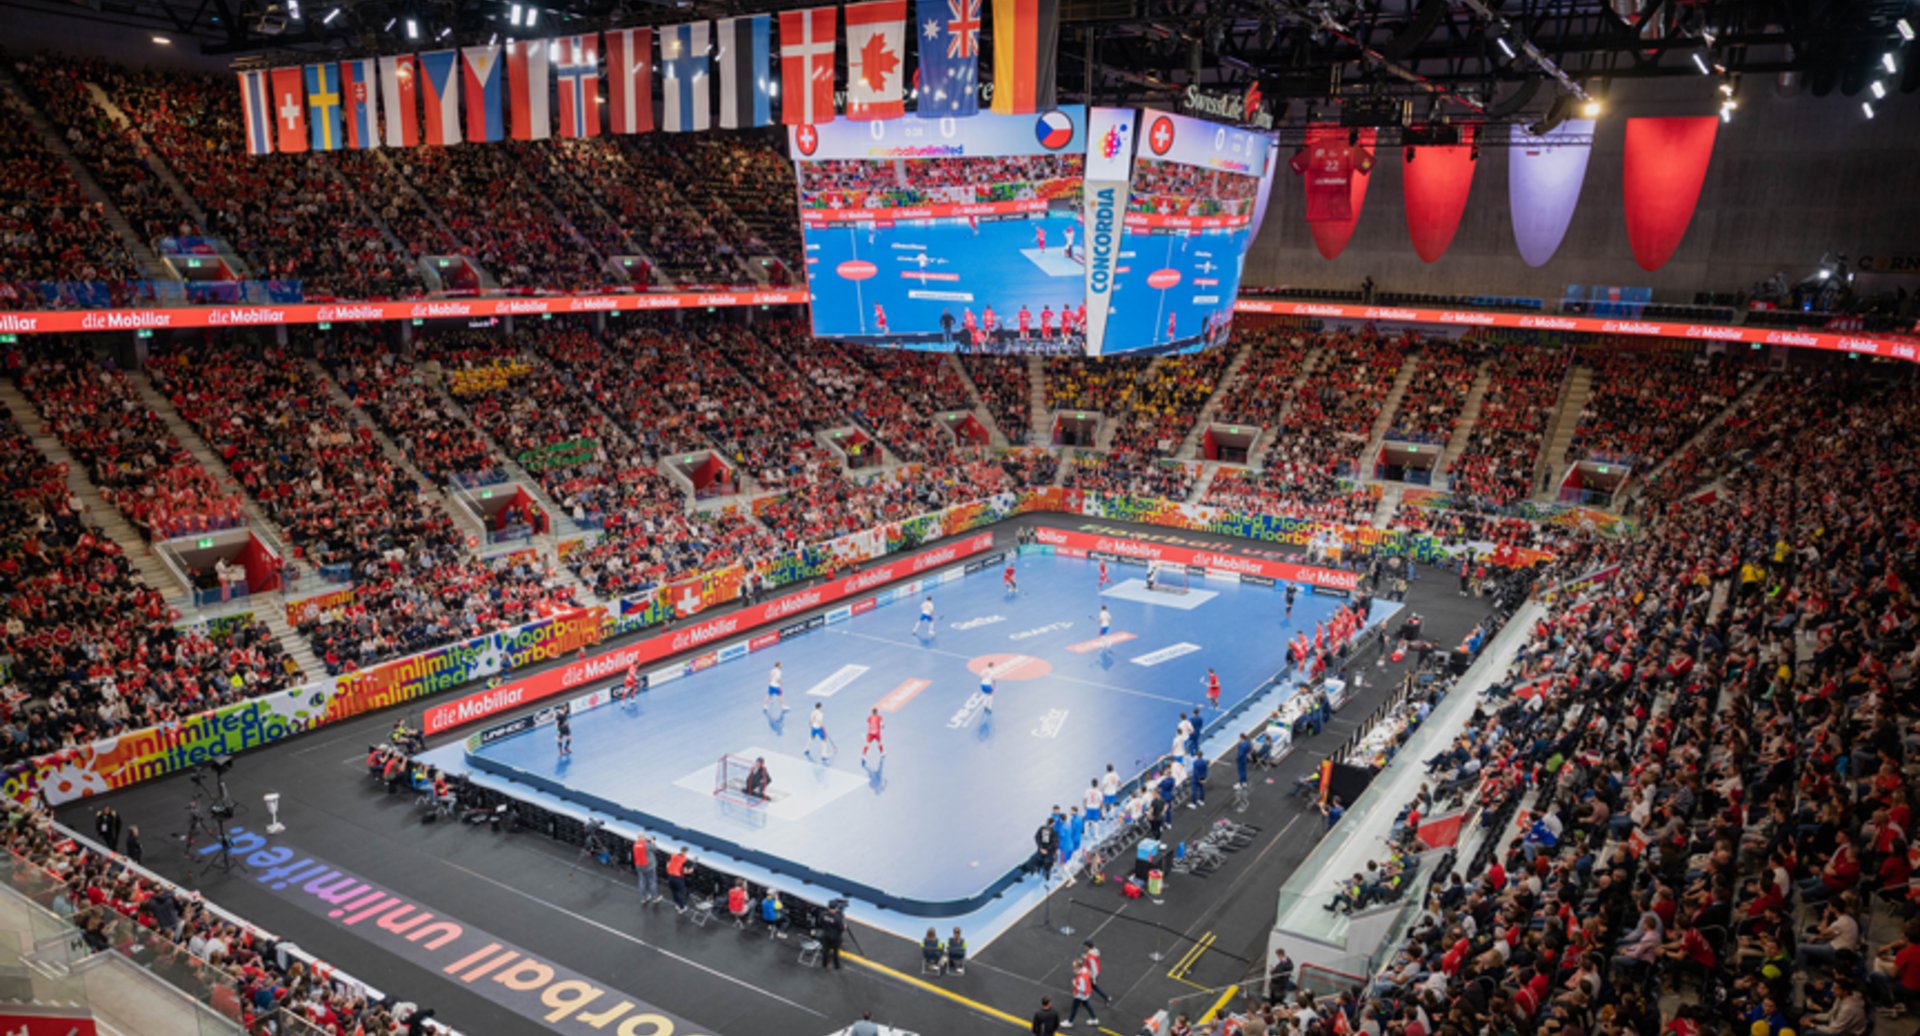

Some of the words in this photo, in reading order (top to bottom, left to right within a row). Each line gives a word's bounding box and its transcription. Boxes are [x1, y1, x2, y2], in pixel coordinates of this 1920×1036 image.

[1091, 187, 1115, 294] CONCORDIA
[411, 304, 427, 316] die
[428, 302, 470, 315] Mobiliar
[510, 300, 548, 312] Mobiliar
[584, 298, 618, 309] Mobiliar
[1308, 304, 1343, 316] Mobiliar
[82, 313, 105, 328] die
[107, 312, 170, 328] Mobiliar
[208, 309, 227, 323] die
[230, 308, 285, 323] Mobiliar
[317, 307, 334, 320] die
[335, 306, 383, 319] Mobiliar
[1379, 308, 1417, 320] Mobiliar
[1455, 312, 1495, 324] Mobiliar
[1535, 317, 1577, 329] Mobiliar
[1618, 321, 1661, 335] Mobiliar
[1702, 326, 1743, 340] Mobiliar
[1096, 539, 1112, 551] die
[1114, 541, 1161, 558] Mobiliar
[924, 549, 956, 565] Mobiliar
[1192, 552, 1210, 566] die
[1212, 554, 1263, 574] Mobiliar
[844, 576, 857, 593] die
[858, 567, 893, 587] Mobiliar
[1296, 568, 1316, 583] die
[764, 603, 779, 620] die
[780, 592, 821, 613] Mobiliar
[672, 634, 690, 651] die
[690, 619, 738, 643] Mobiliar
[562, 668, 584, 687] die
[585, 650, 640, 679] Mobiliar
[432, 708, 457, 730] die
[458, 688, 523, 718] Mobiliar
